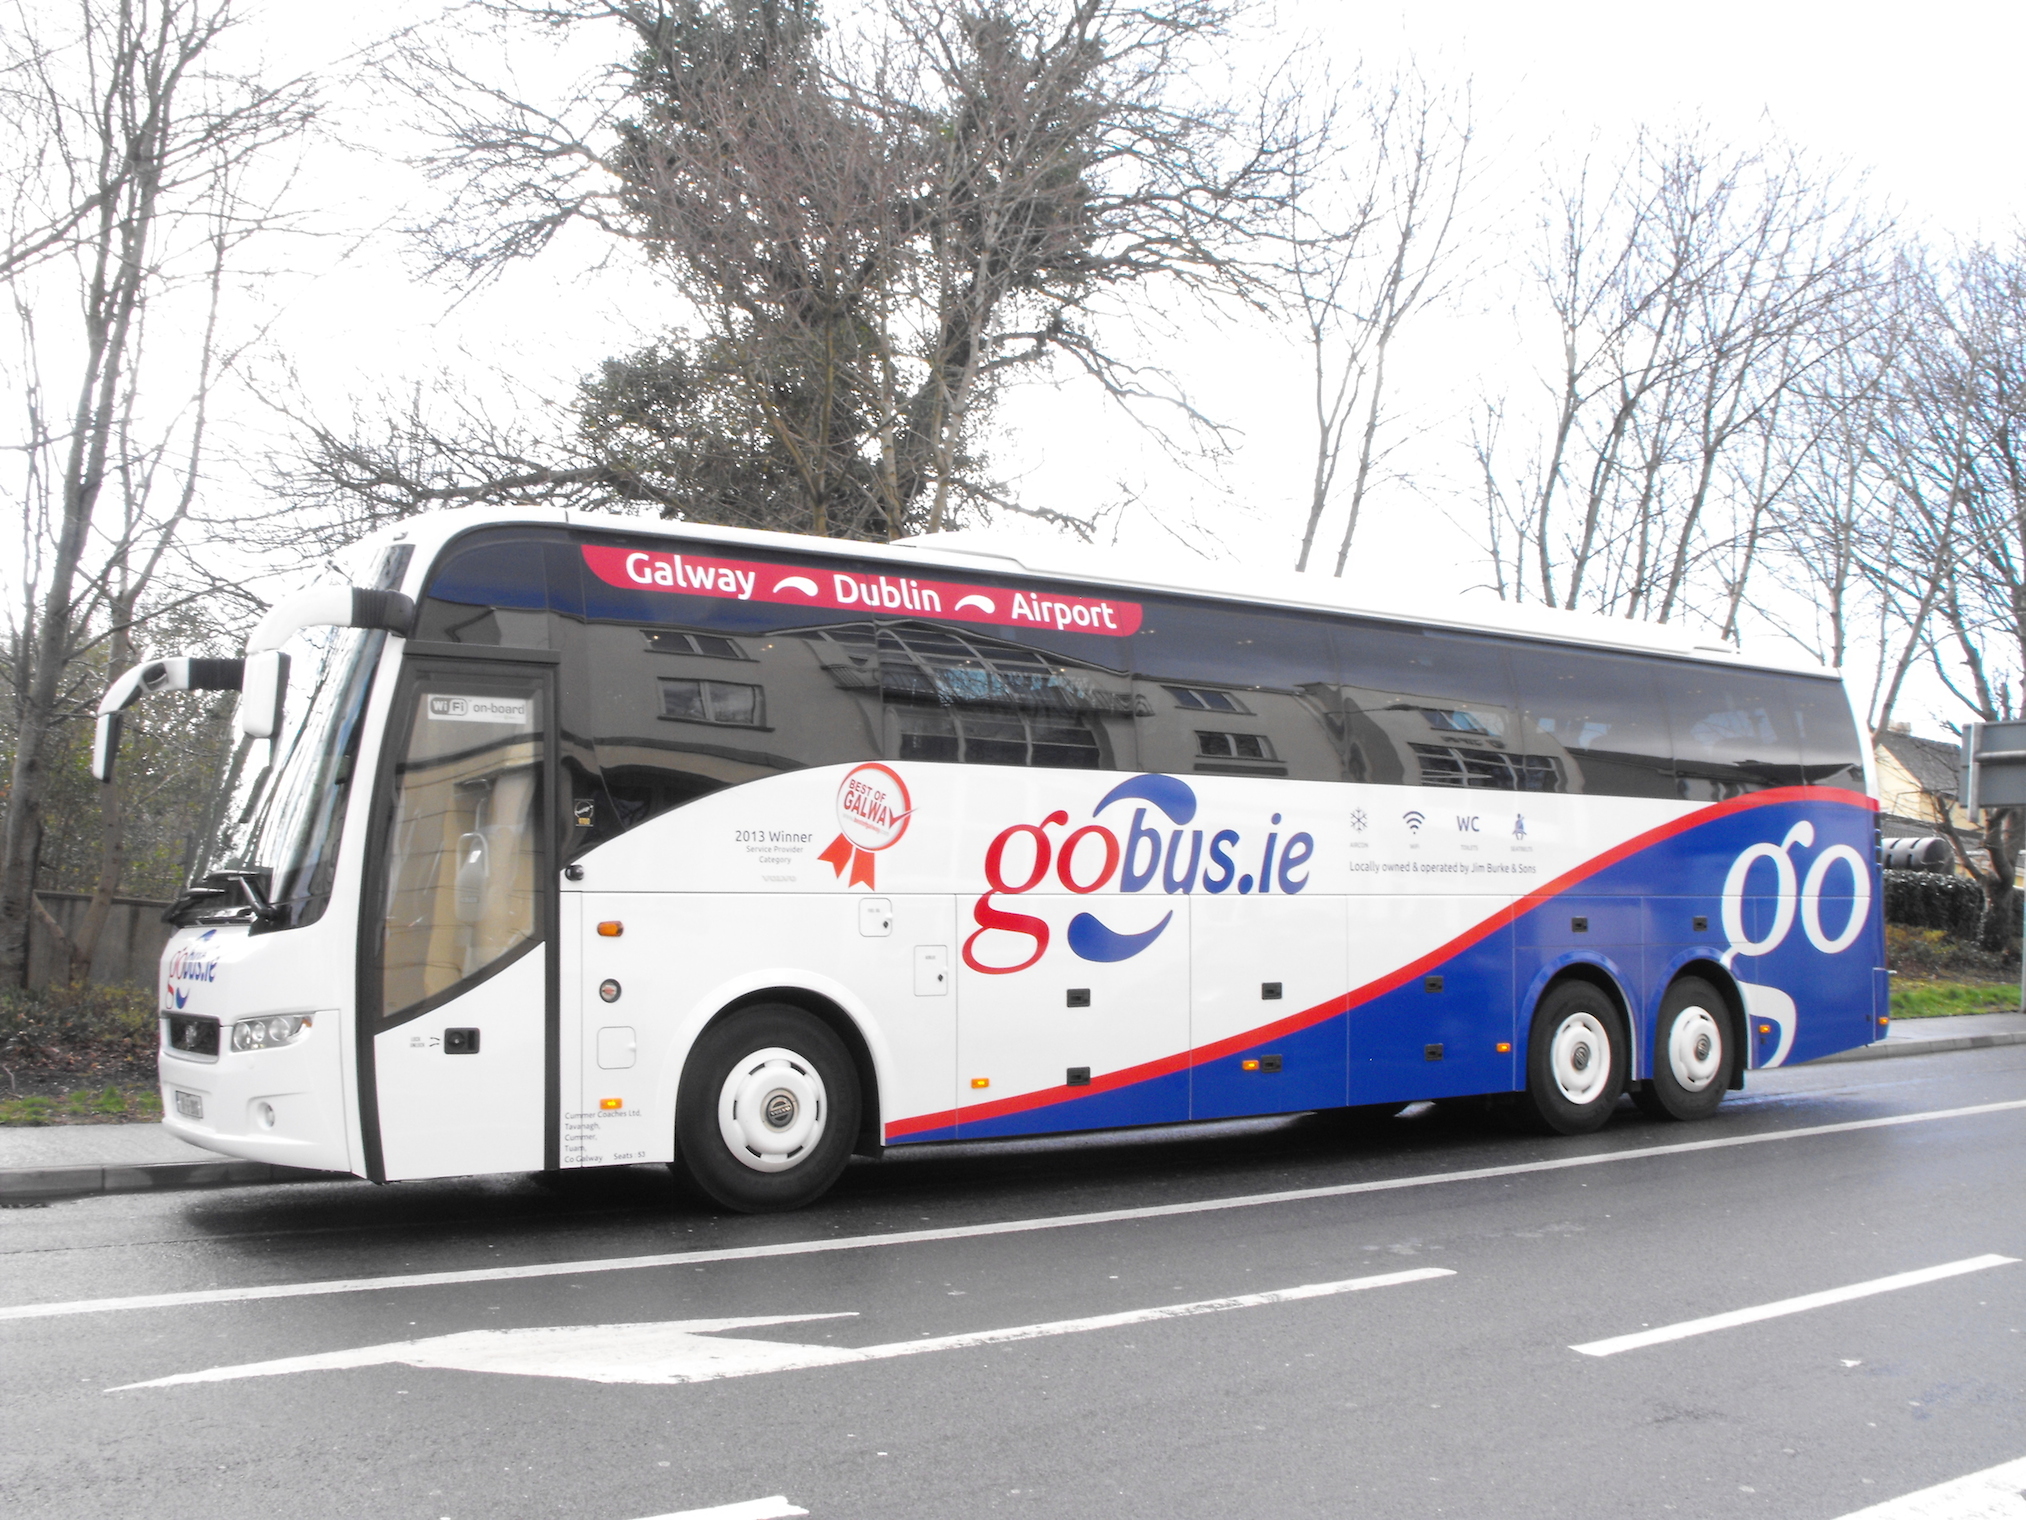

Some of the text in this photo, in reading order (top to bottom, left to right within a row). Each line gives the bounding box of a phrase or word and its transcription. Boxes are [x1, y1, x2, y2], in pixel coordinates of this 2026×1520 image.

[625, 552, 1118, 632] Galway Dublin Airport
[473, 703, 525, 714] on-board
[849, 779, 886, 803] BEST OF
[1456, 815, 1480, 832] WC
[735, 830, 813, 843] 2013 Winner
[746, 845, 804, 853] Service Provider
[759, 856, 792, 865] Category
[1349, 861, 1380, 874] Locally
[1381, 861, 1410, 872] owned
[1420, 862, 1458, 875] operated
[1459, 862, 1469, 875] by
[1471, 862, 1485, 873] Jim
[1487, 863, 1509, 874] Burke
[1518, 863, 1536, 874] Sons
[962, 808, 1314, 975] gobus.ie
[1719, 820, 1871, 1069] go
[597, 1110, 627, 1118] Coaches
[575, 1155, 603, 1163] Galway
[613, 1152, 633, 1160] Seats
